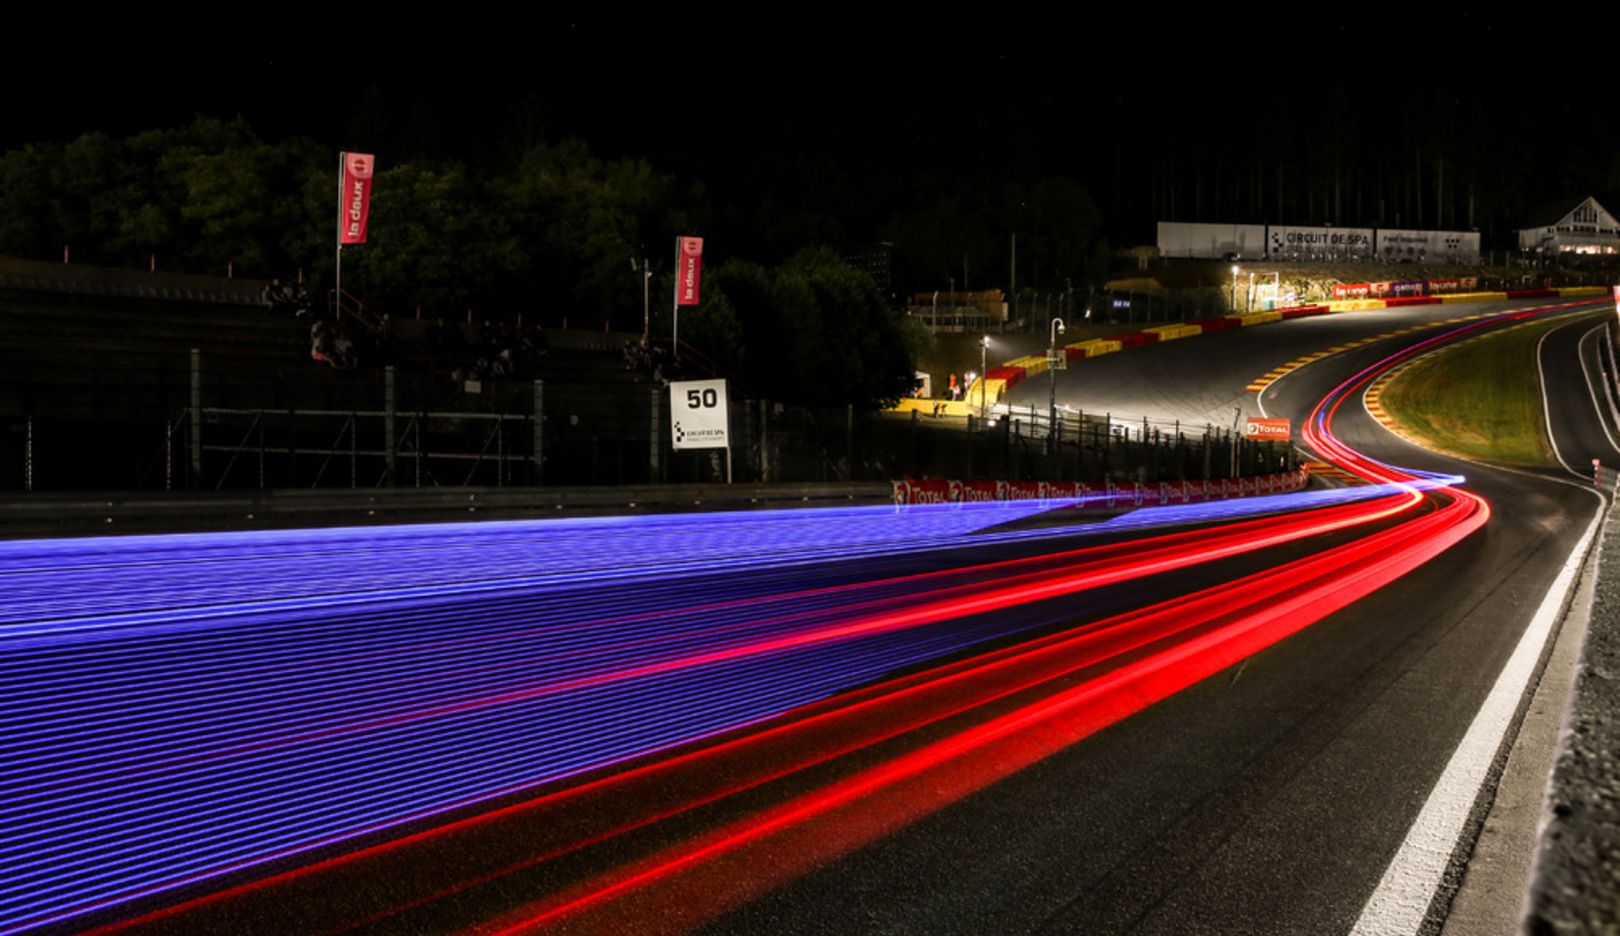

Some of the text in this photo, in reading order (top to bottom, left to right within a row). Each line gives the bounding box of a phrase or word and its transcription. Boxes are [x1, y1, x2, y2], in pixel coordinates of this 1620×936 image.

[347, 222, 359, 237] la
[1286, 232, 1369, 245] CIRCUIT DE SPA
[687, 388, 717, 409] 50
[1260, 424, 1286, 433] TOTAL
[912, 486, 947, 505] TOTAL
[965, 486, 994, 502] TOTAL
